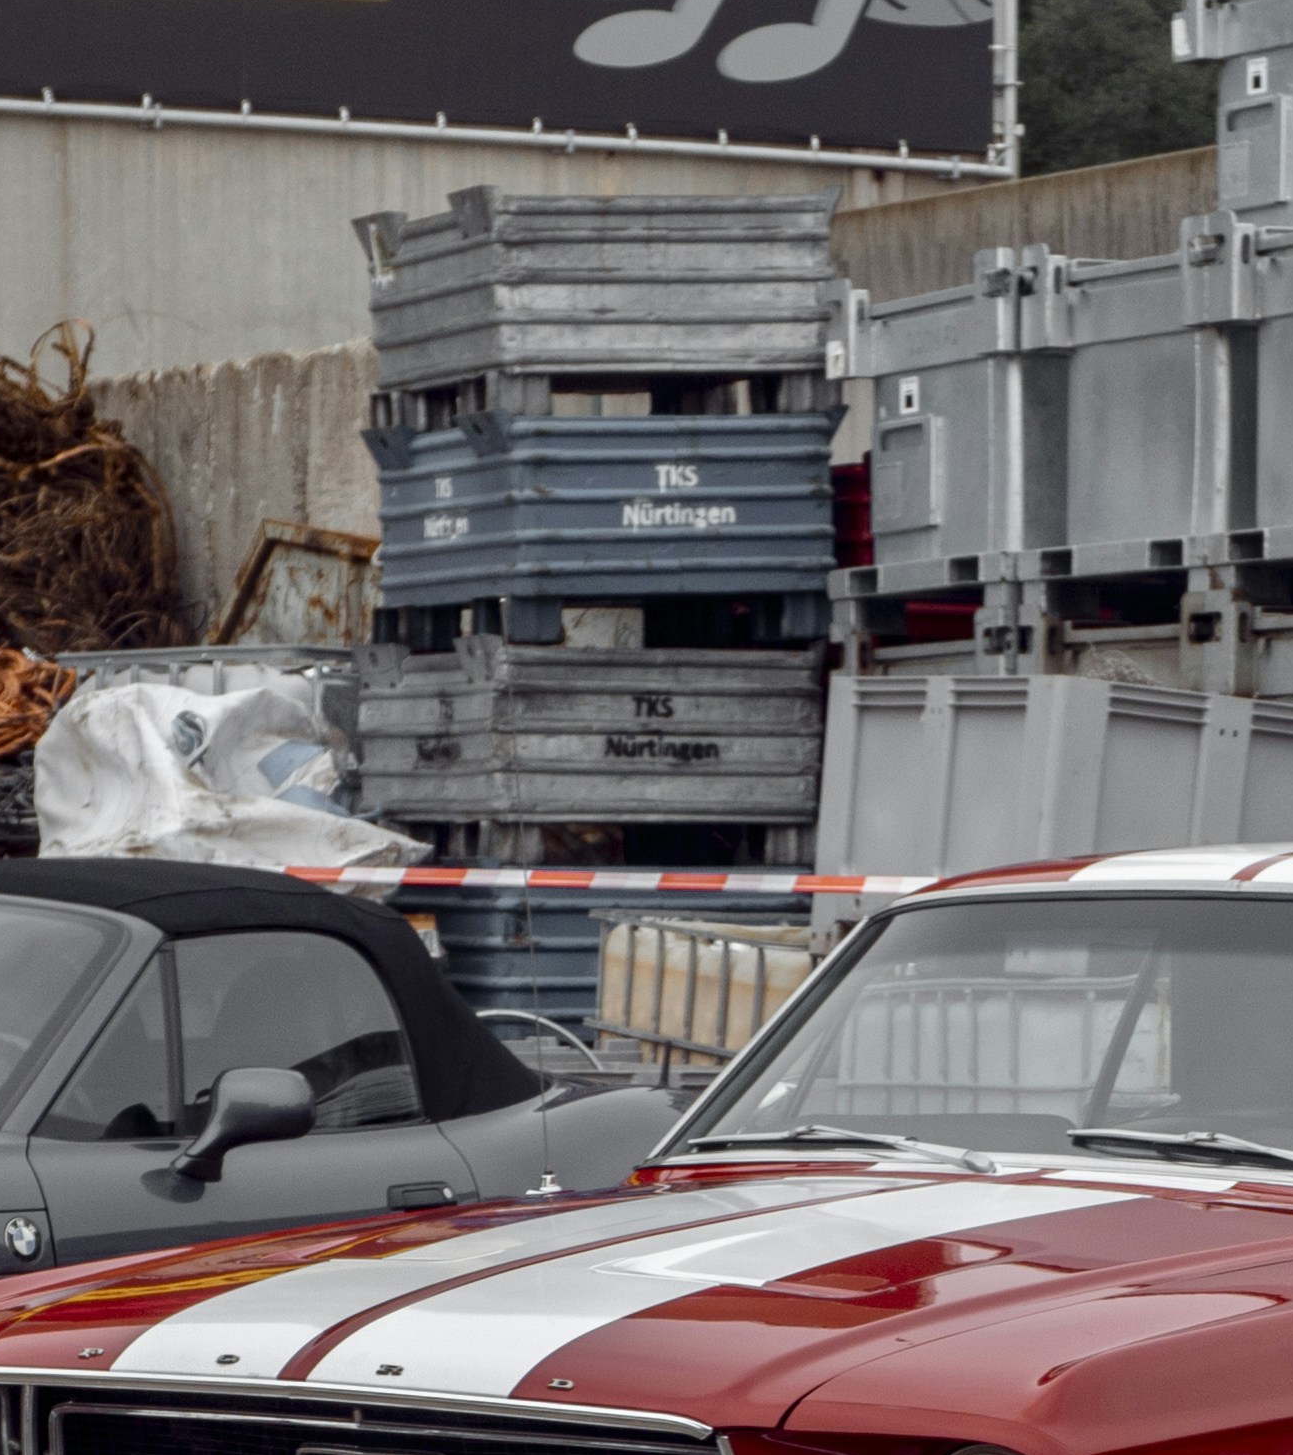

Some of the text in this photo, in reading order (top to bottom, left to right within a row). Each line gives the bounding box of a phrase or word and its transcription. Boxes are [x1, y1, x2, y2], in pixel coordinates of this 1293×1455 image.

[655, 464, 699, 488] TKS
[622, 502, 737, 529] Nürtingen
[632, 696, 674, 718] TKS
[604, 733, 720, 763] Nürtingen
[78, 1346, 575, 1392] FORD
